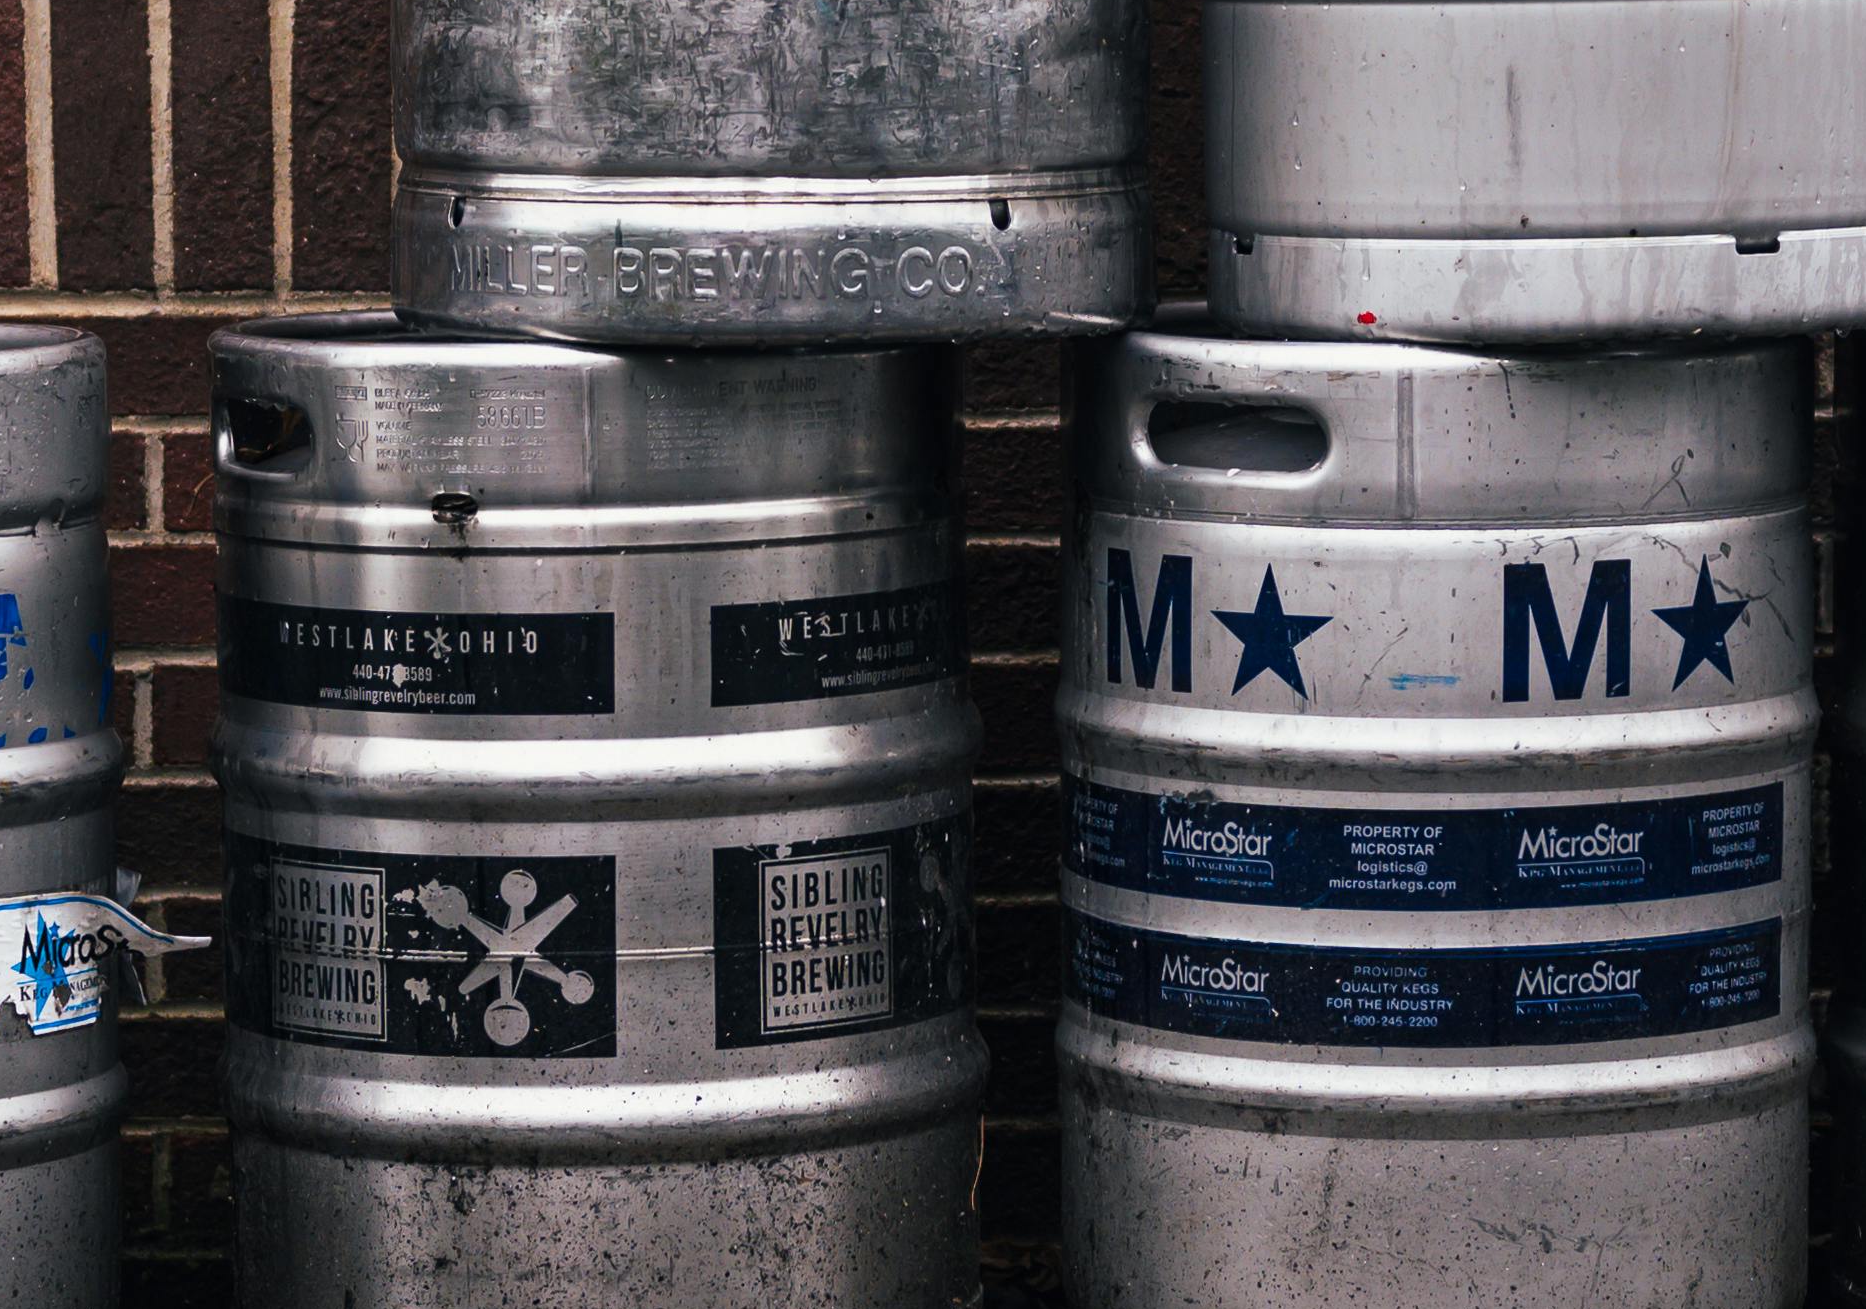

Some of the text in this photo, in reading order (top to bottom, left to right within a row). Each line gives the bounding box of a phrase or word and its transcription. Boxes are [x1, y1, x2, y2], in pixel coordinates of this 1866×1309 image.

[449, 244, 589, 297] MILLER
[614, 246, 870, 302] BREWING
[778, 605, 910, 641] WESTLAKE
[1106, 547, 1193, 694] M
[1501, 558, 1632, 703] M
[279, 620, 538, 654] WESTLAKE OHIO
[352, 664, 433, 682] 440-478589
[319, 686, 476, 707] www.siblingrevelrybeer.com
[1702, 801, 1765, 823] PROPERTY OF
[1162, 816, 1273, 857] MicroStar
[1343, 824, 1443, 839] PROPERTY OF
[1708, 819, 1760, 840] MICROSTAR
[1350, 843, 1435, 856] MICROSTAR
[1517, 823, 1644, 859] MicroStar
[1712, 838, 1756, 856] logistics@
[1357, 860, 1428, 876] logistics@
[1691, 854, 1771, 876] microstarkegs.com
[770, 863, 884, 912] SIBLING
[1328, 876, 1456, 893] microstarkegs.com
[277, 916, 375, 961] REVELRY
[770, 905, 884, 954] REVELRY
[1709, 941, 1756, 959] PROVIDING
[772, 949, 885, 998] BREWING
[1160, 953, 1270, 993] MicroStar
[1354, 965, 1429, 978] PROVIDING
[1515, 960, 1642, 997] MicroStar
[1700, 958, 1761, 978] QUALITY KEGS
[279, 959, 377, 1005] BREWING
[1341, 981, 1439, 995] QUALITY KEGS
[1689, 971, 1768, 994] FOR THE INDUSTRY
[772, 1000, 848, 1018] WESTLAKE
[1326, 997, 1454, 1011] FOR THE INDUSTRY
[1342, 1015, 1438, 1027] 1-800-245-2200
